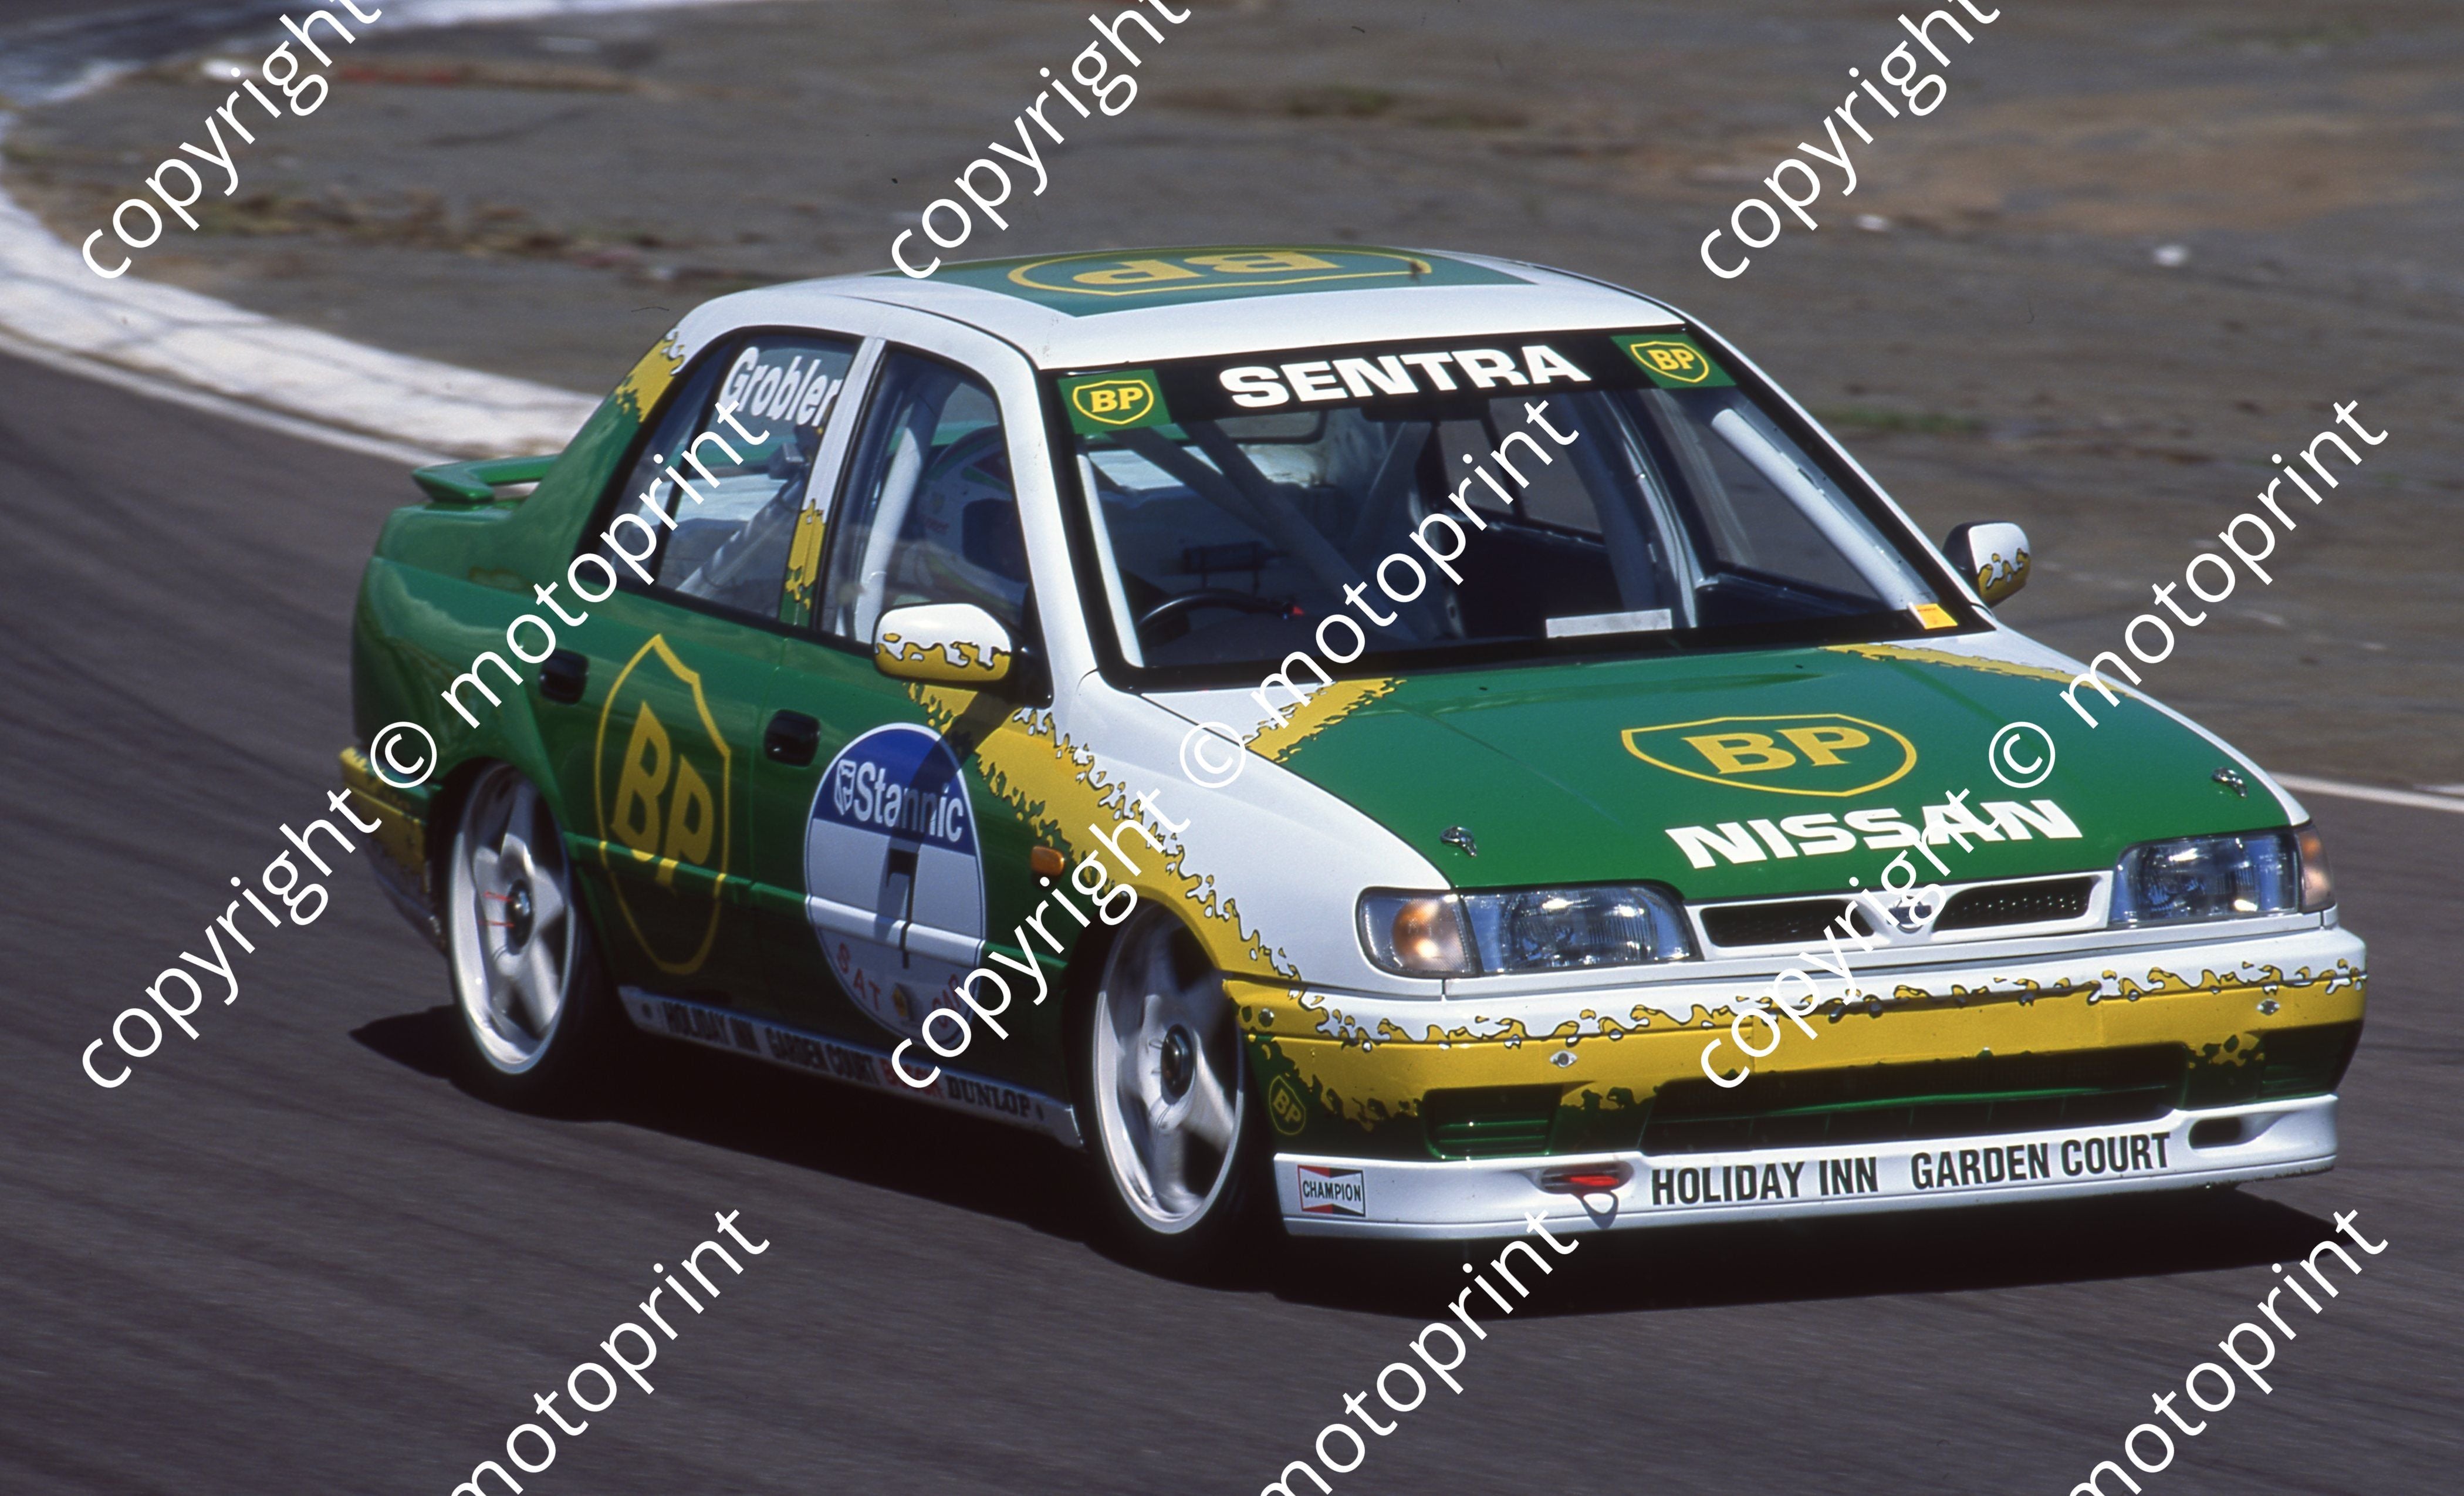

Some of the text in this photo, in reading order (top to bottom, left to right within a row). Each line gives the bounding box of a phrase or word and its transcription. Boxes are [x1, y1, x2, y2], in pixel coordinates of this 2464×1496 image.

[1073, 251, 1344, 285] BP
[1219, 345, 1592, 408] SENTRA
[1647, 347, 1696, 372] BP
[718, 346, 843, 426] Grobler
[1090, 386, 1144, 413] BP
[1681, 726, 1871, 775] BP
[611, 699, 715, 897] BP
[853, 762, 965, 843] Stannic
[1664, 799, 2083, 869] NISSAN
[945, 1075, 1031, 1117] DUNLOP
[1272, 1088, 1302, 1123] BP
[1302, 1178, 1362, 1204] CHAMPION
[1652, 1132, 2171, 1205] HOLIDAY INN GARDEN COURT
